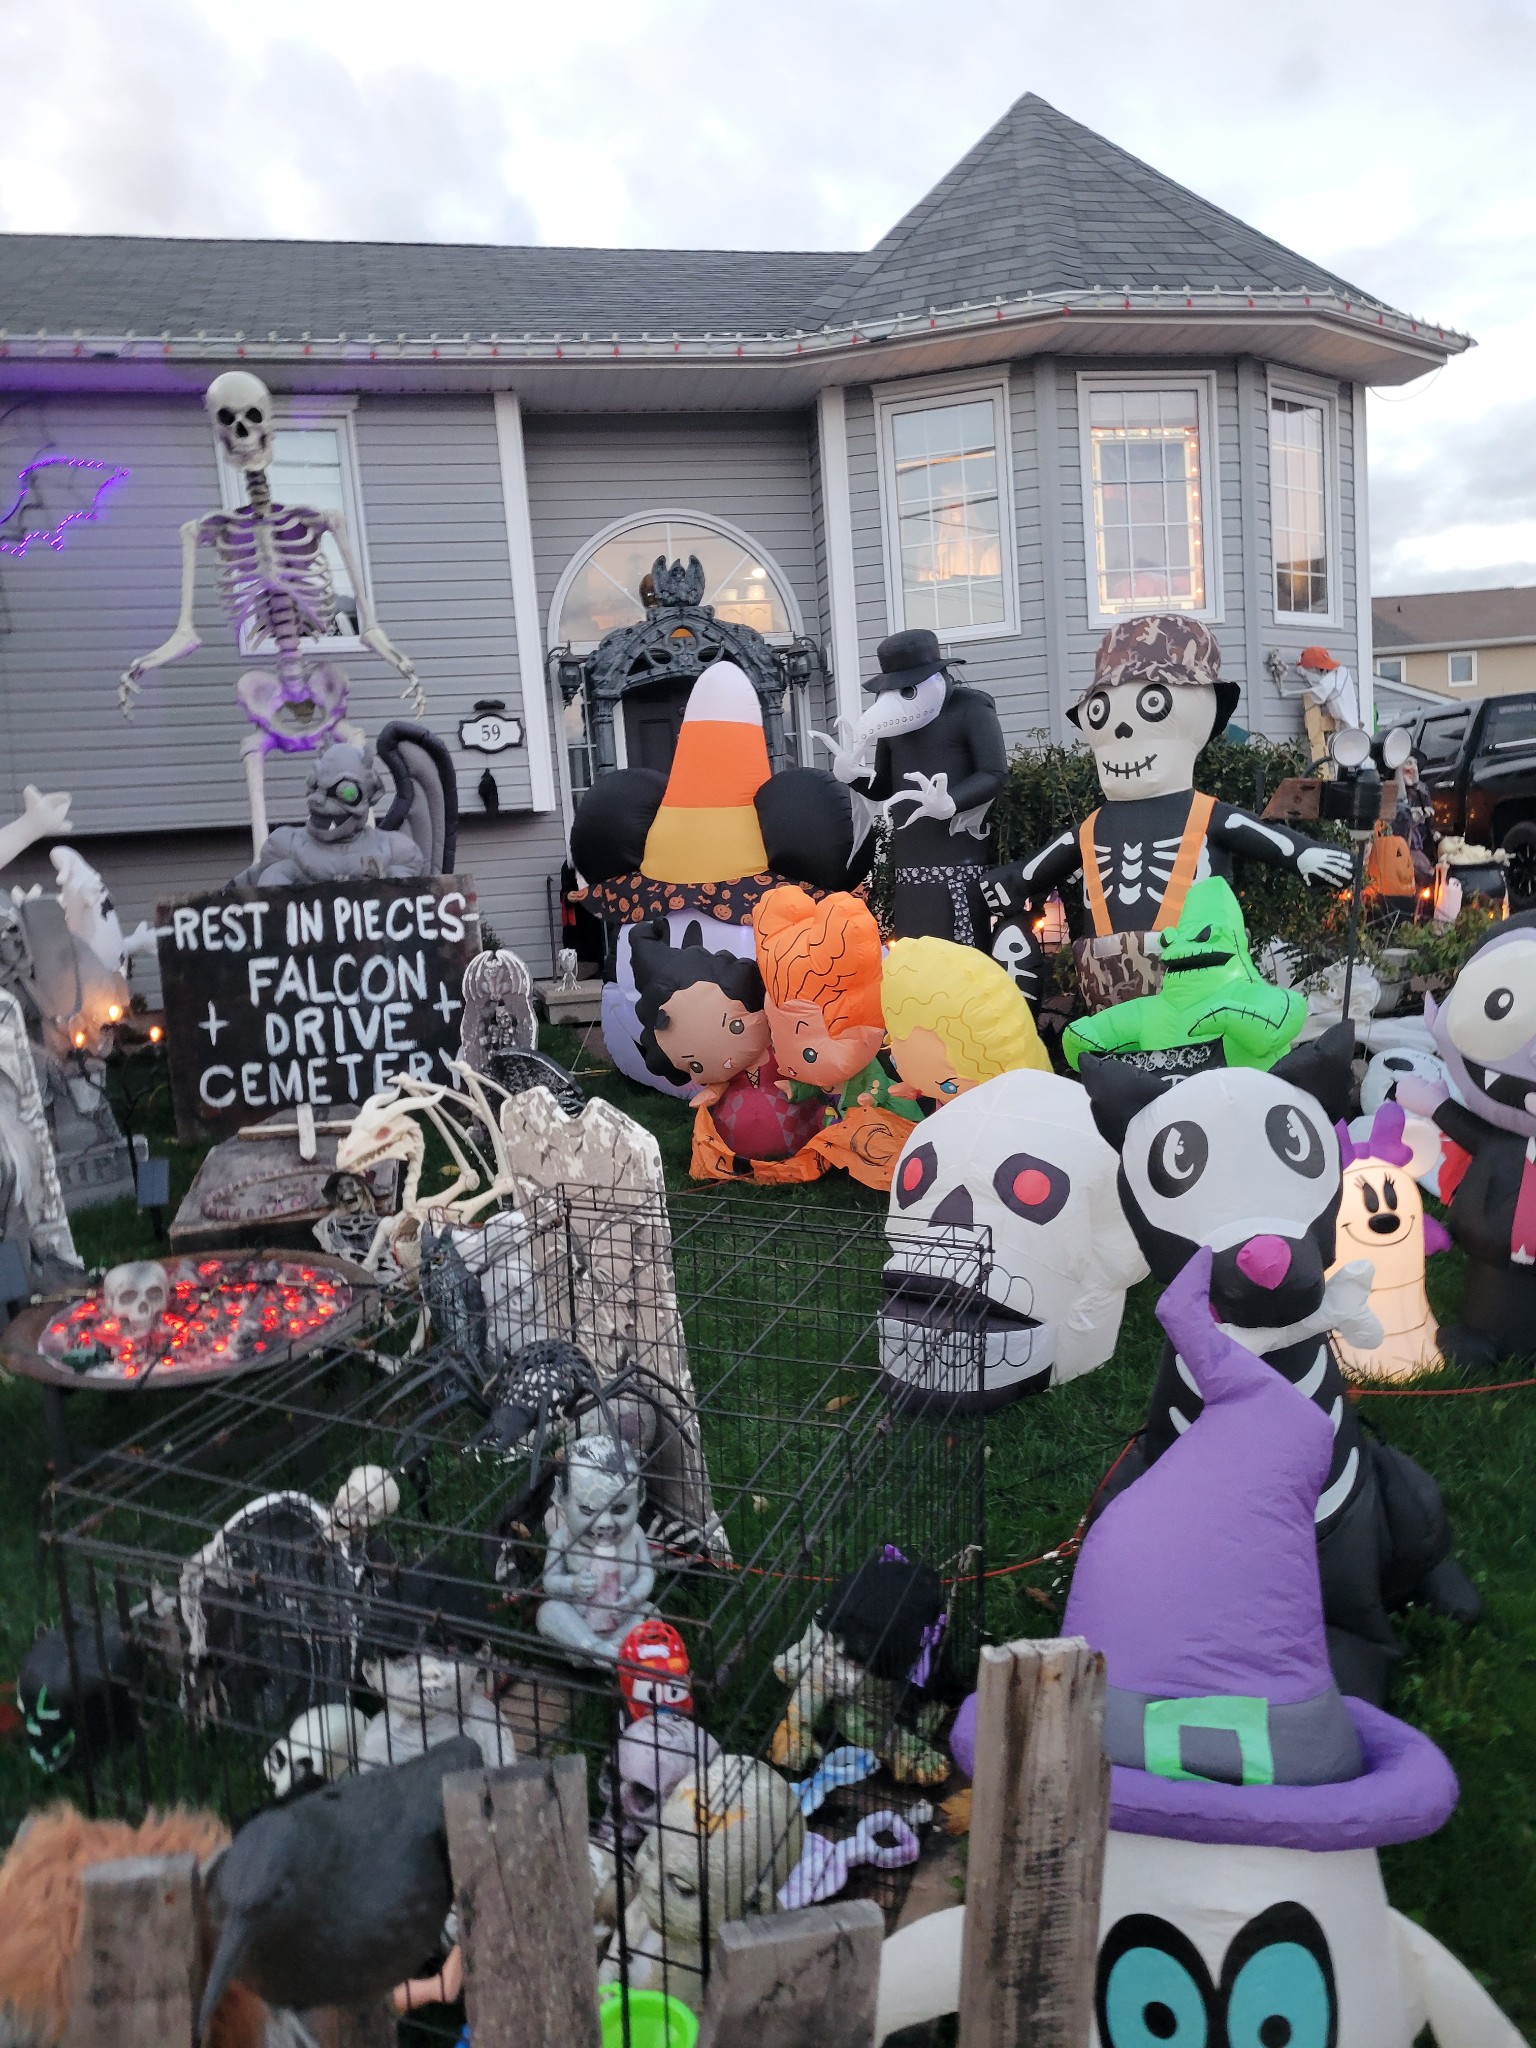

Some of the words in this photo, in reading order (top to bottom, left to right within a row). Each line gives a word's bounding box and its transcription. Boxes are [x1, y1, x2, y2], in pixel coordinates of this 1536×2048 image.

[481, 724, 501, 742] 59
[286, 899, 324, 948] IN
[248, 950, 428, 1008] FALCON
[265, 1001, 418, 1057] DRIVE
